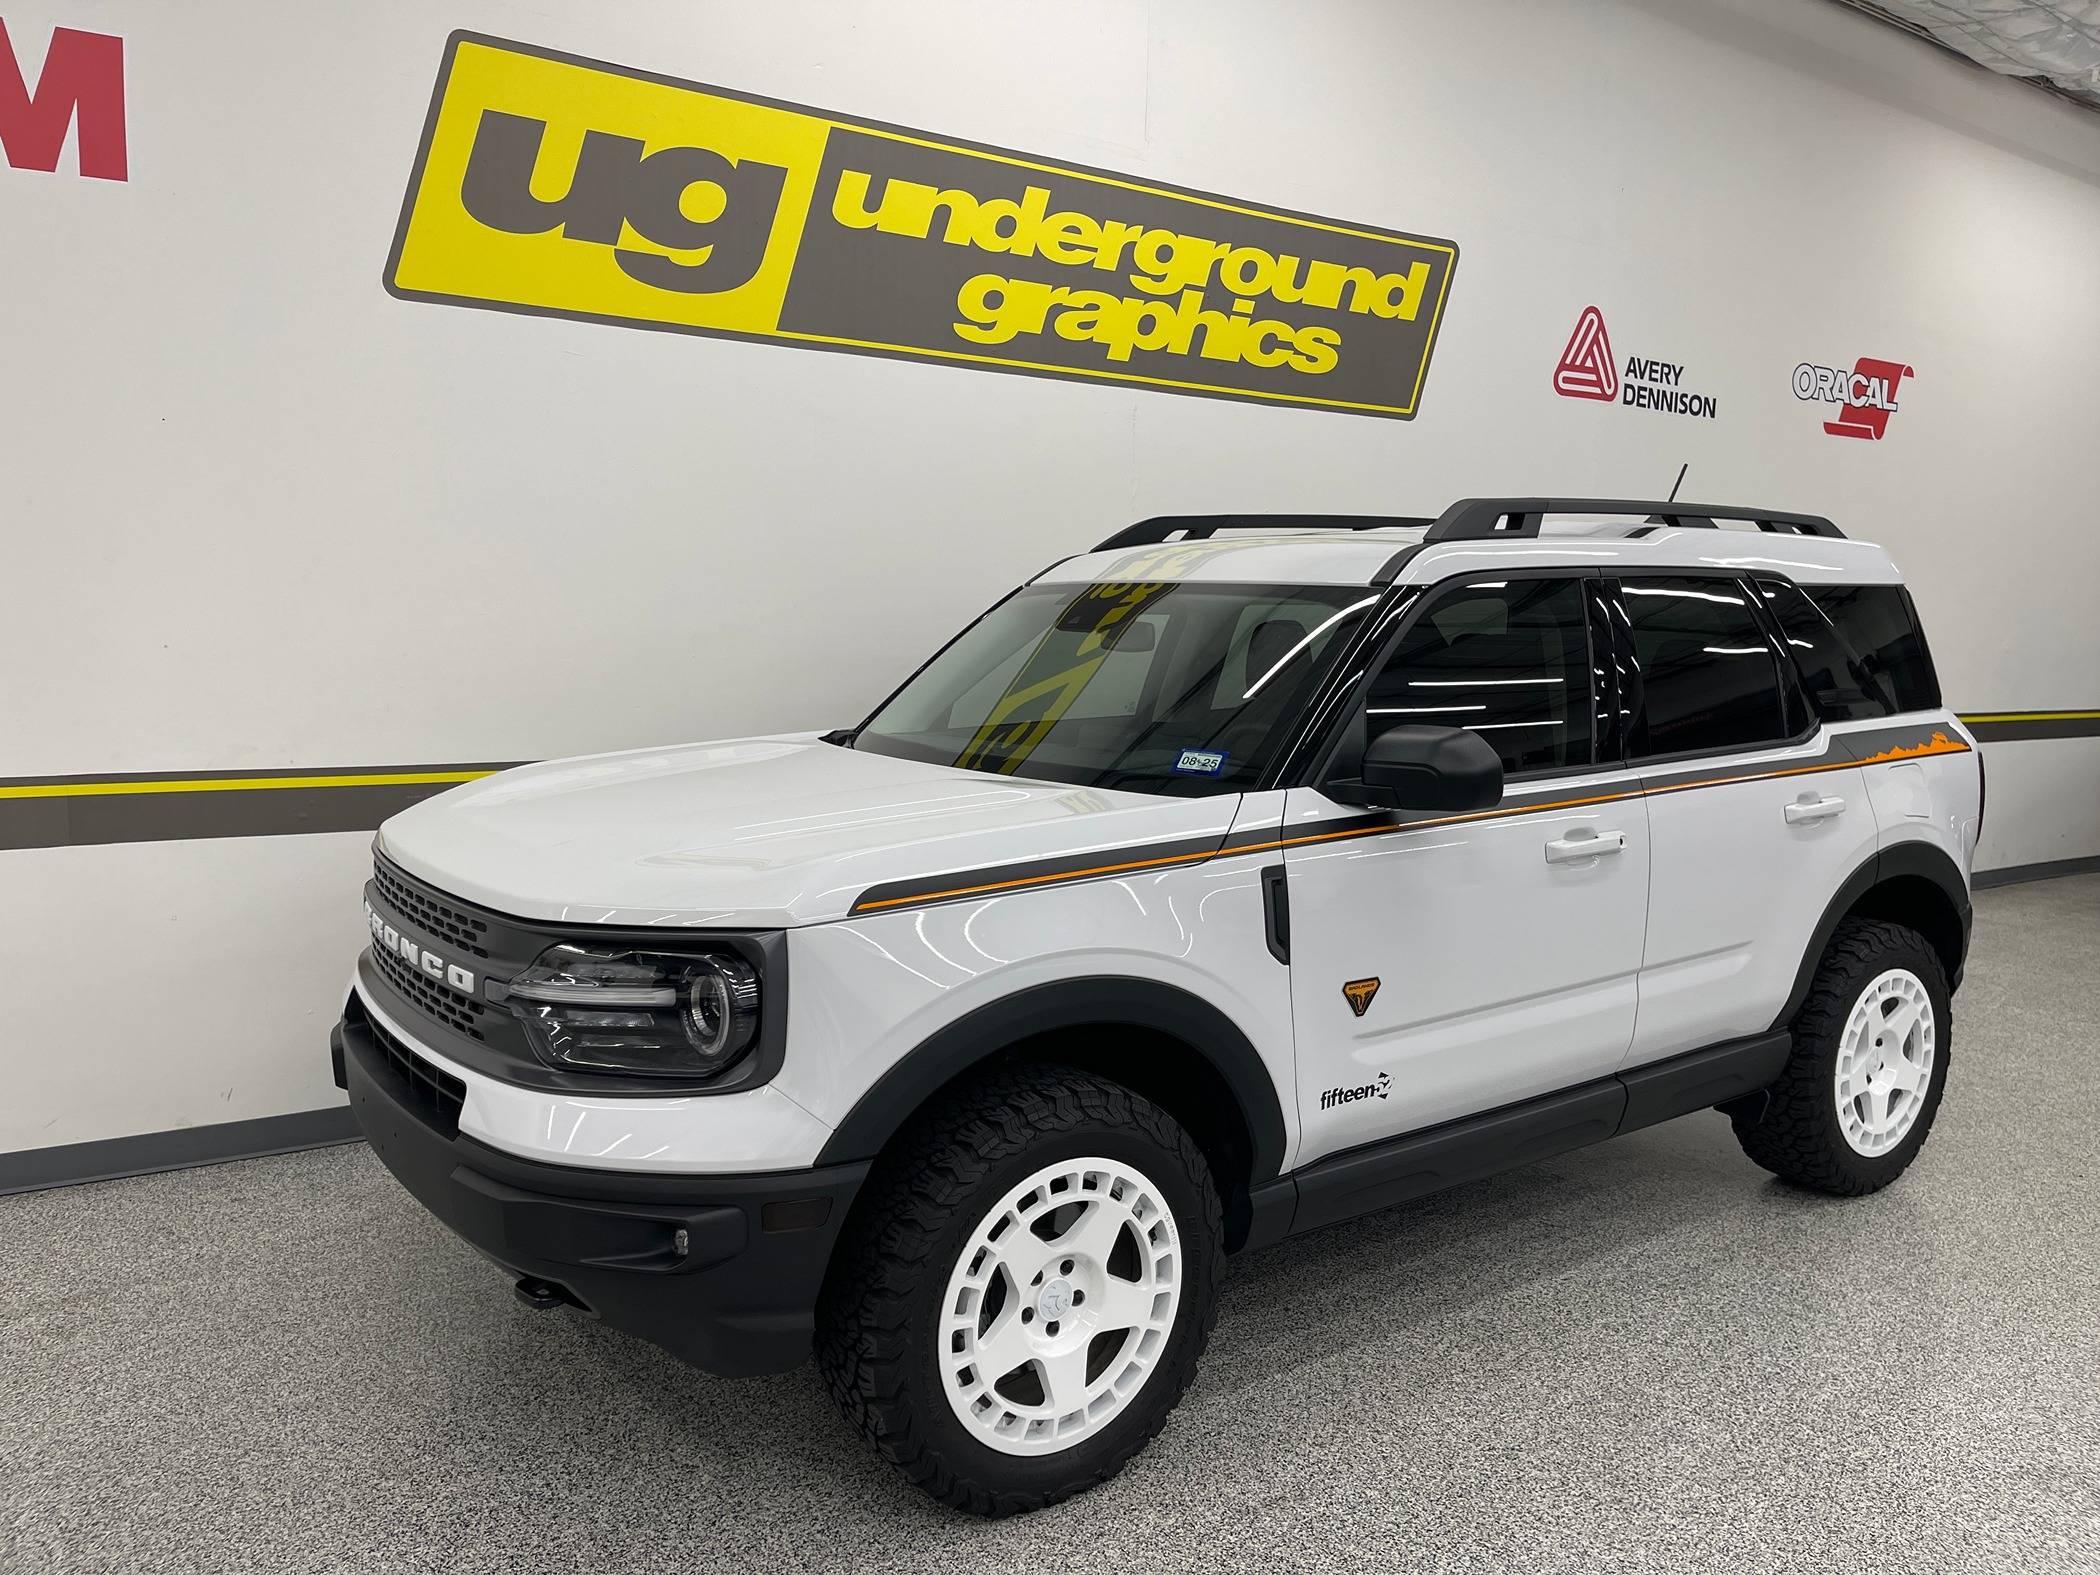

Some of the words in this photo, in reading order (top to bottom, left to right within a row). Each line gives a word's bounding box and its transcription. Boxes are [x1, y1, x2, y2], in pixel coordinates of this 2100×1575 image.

[0, 17, 129, 183] M
[460, 109, 788, 294] ug
[832, 169, 1431, 321] underground
[953, 274, 1342, 374] graphics
[1624, 356, 1684, 386] AVERY
[1622, 383, 1717, 419] DENNISON
[1792, 363, 1898, 412] ORACAL
